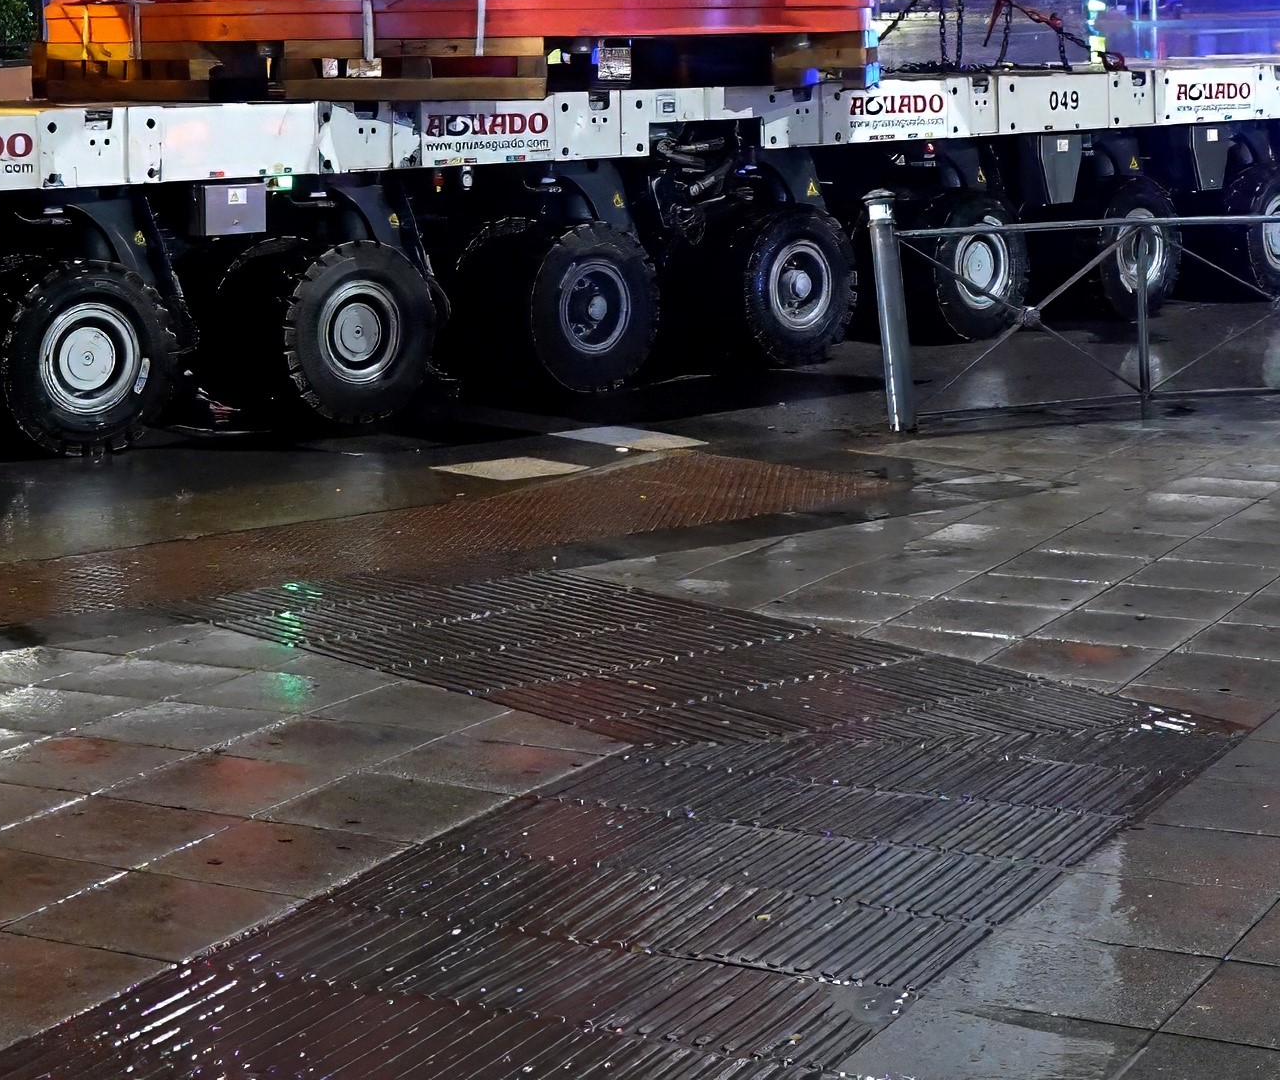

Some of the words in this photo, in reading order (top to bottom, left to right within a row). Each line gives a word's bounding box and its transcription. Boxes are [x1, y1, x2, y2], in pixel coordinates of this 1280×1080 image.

[1049, 90, 1079, 111] 049
[1176, 82, 1251, 101] AGUADO
[849, 93, 944, 116] AGUADO
[426, 112, 549, 138] AGUADO
